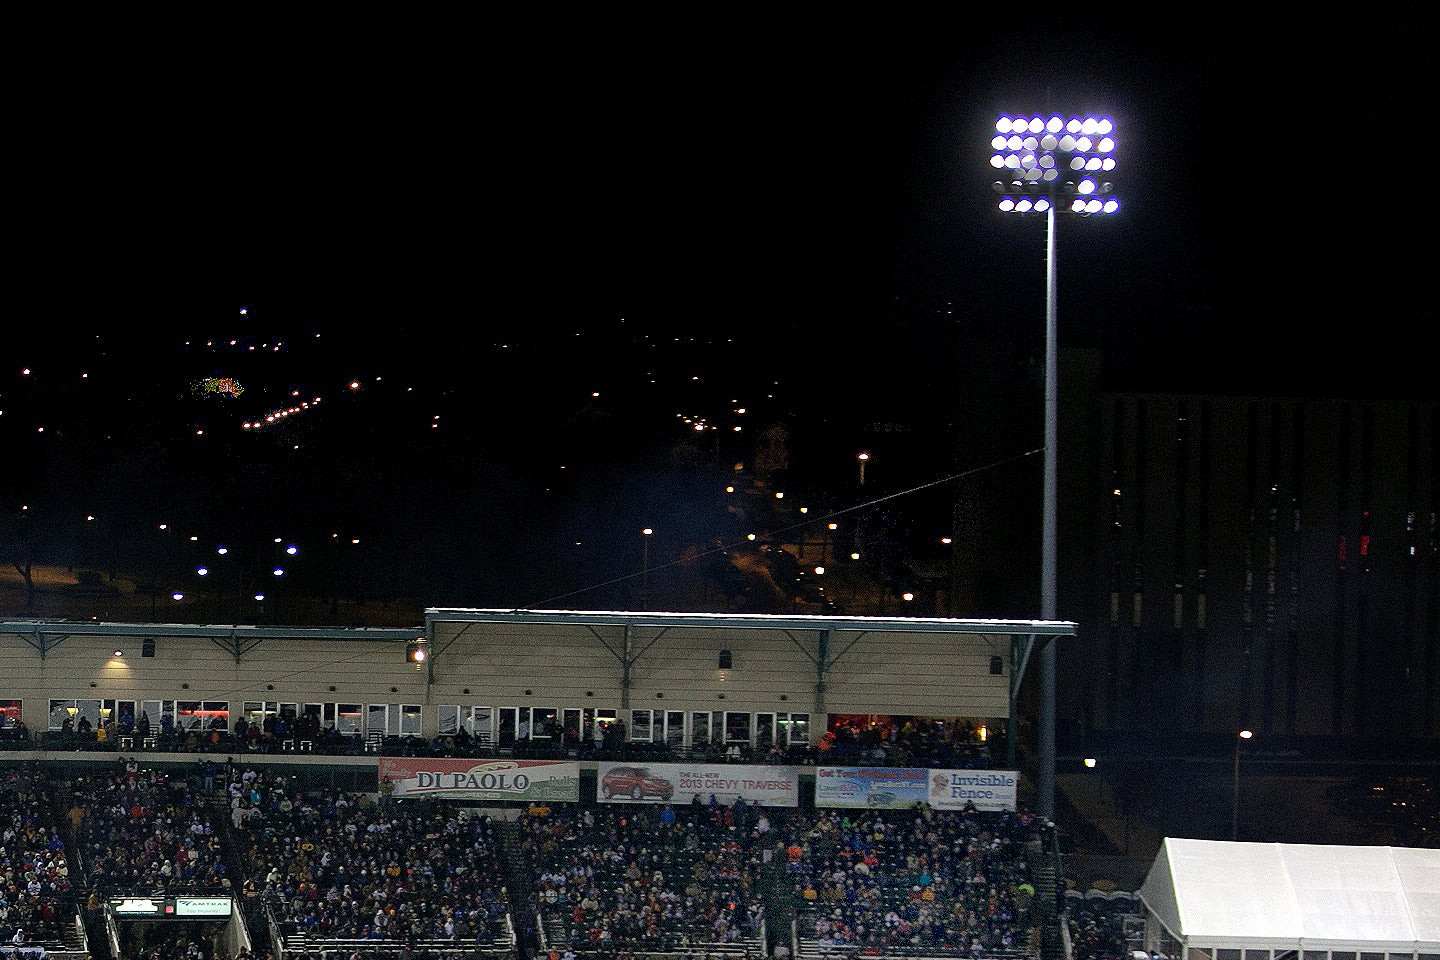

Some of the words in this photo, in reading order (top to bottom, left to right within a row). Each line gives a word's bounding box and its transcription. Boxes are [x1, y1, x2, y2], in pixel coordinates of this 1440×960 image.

[417, 772, 442, 788] DI
[453, 773, 529, 790] PAOLO
[679, 778, 703, 789] 2013
[706, 779, 739, 790] CHEVY
[742, 780, 792, 791] TRAVERSE
[951, 773, 1014, 787] Invisible
[951, 786, 993, 799] Fence
